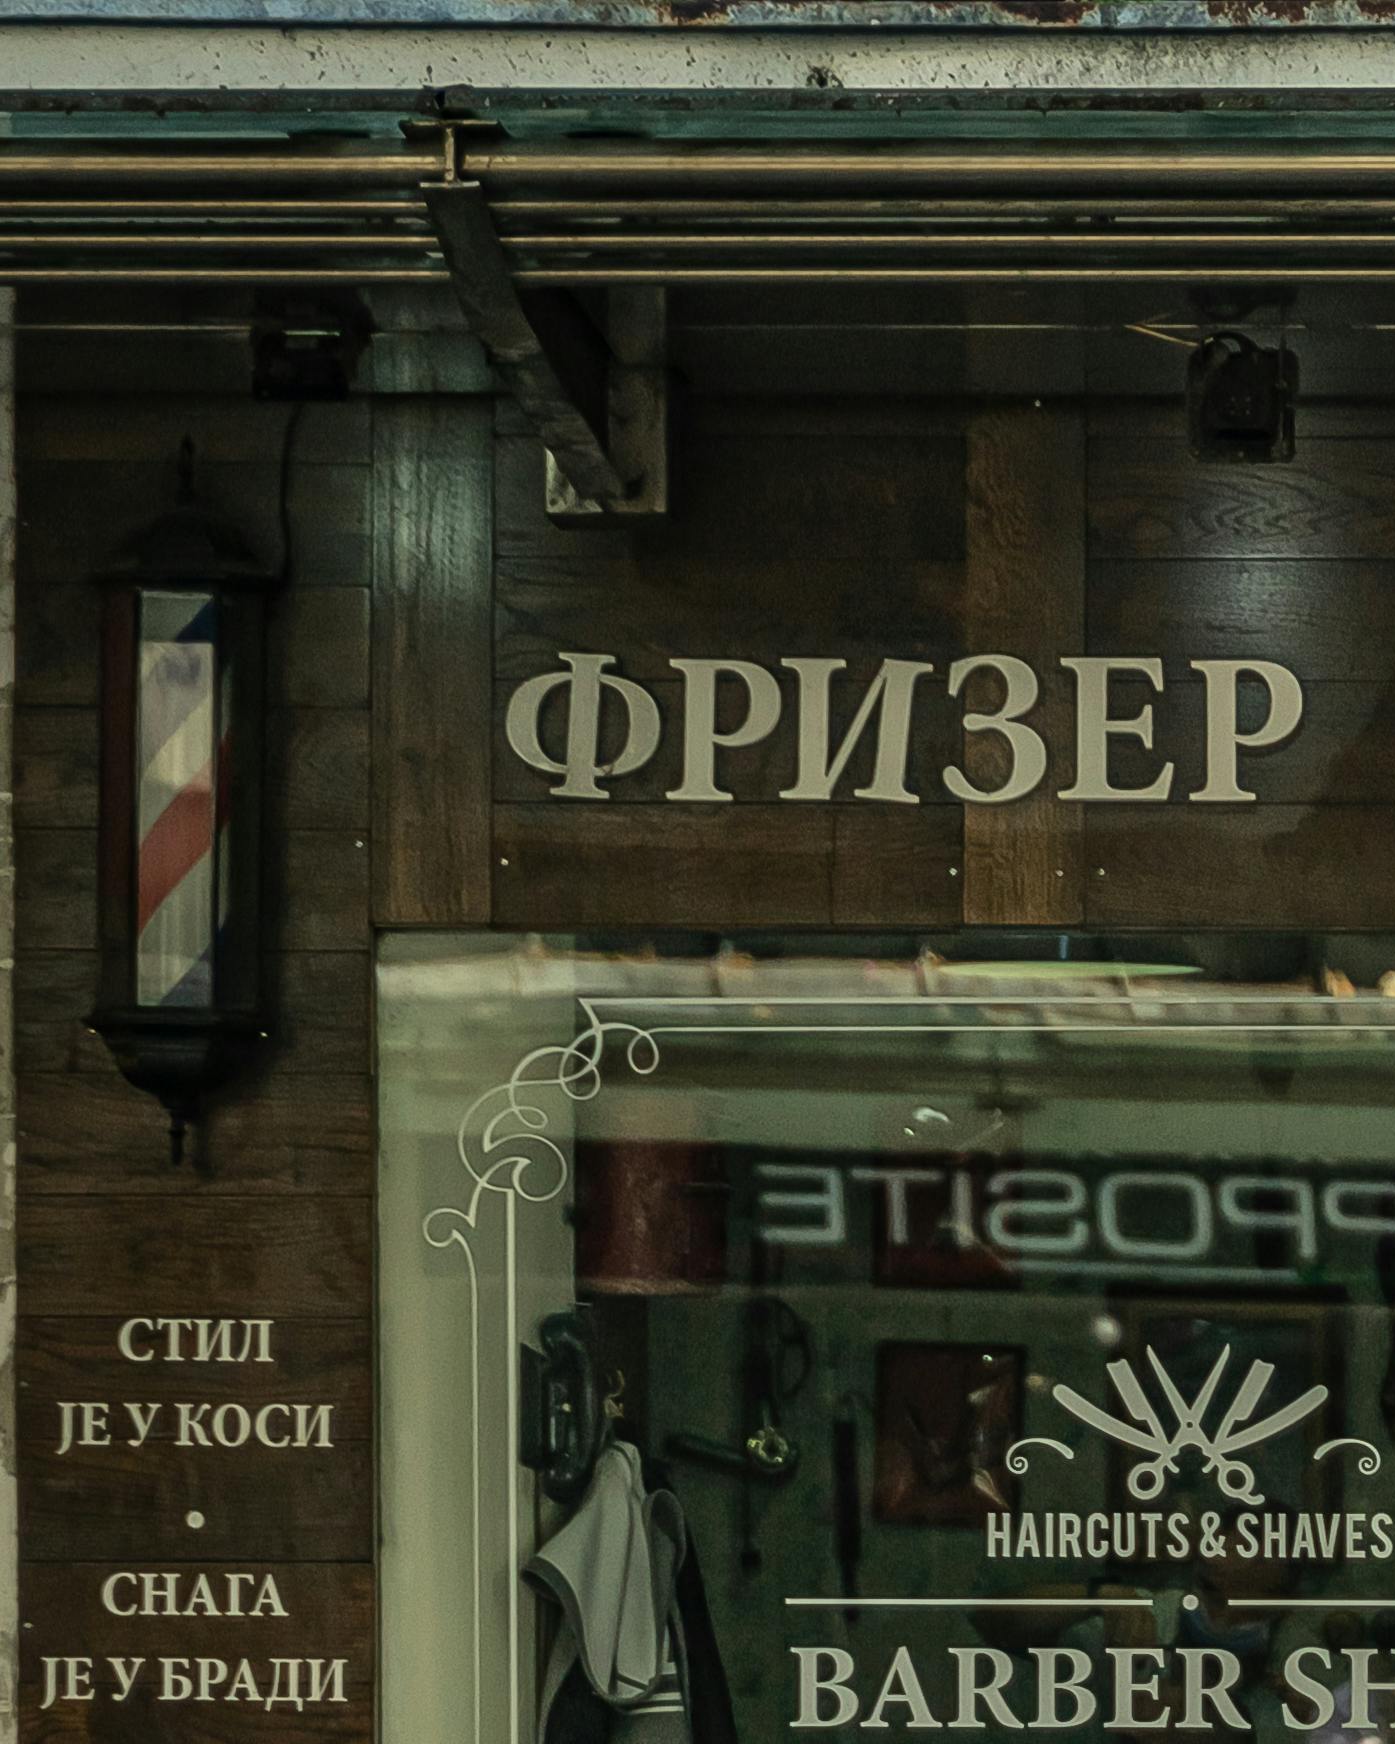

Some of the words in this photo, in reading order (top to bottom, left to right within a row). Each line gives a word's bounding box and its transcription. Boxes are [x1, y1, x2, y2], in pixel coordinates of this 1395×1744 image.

[505, 651, 1303, 804] ФРИЗЕР
[118, 1317, 275, 1363] СТИЛ
[56, 1401, 112, 1455] ЈЕ
[123, 1402, 163, 1447] У
[174, 1403, 334, 1448] КОСИ
[987, 1512, 1190, 1559] HAIRCUTS
[1199, 1511, 1227, 1558] &
[1235, 1512, 1394, 1559] SHAVES
[102, 1572, 290, 1617] СНАГА
[39, 1656, 95, 1710] ЈЕ
[106, 1657, 146, 1702] У
[157, 1657, 349, 1712] БРАДИ
[789, 1645, 1252, 1730] BARBER
